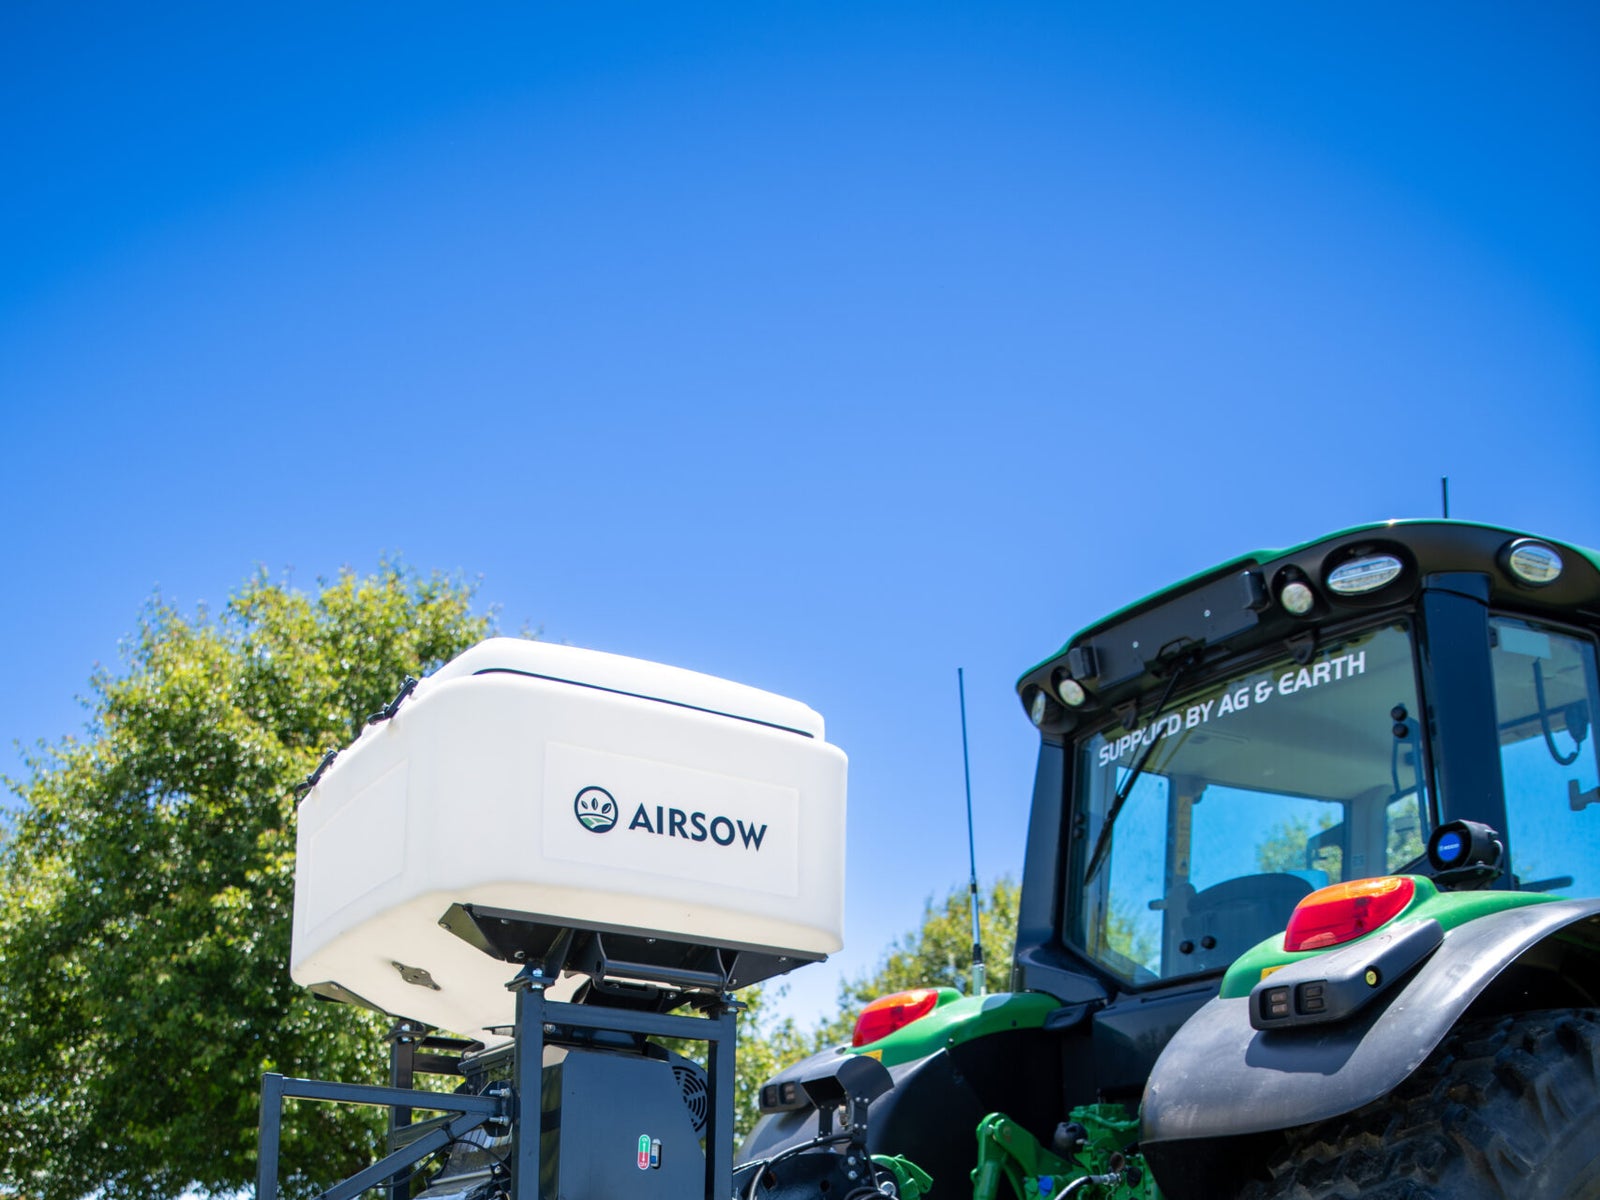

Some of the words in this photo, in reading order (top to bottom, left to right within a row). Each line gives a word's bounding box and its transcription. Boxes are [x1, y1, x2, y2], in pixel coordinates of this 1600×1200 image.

[1185, 700, 1214, 730] BY
[1217, 687, 1249, 718] AG
[1254, 680, 1274, 704] &
[1278, 651, 1366, 696] EARTH
[628, 802, 768, 852] AIRSOW
